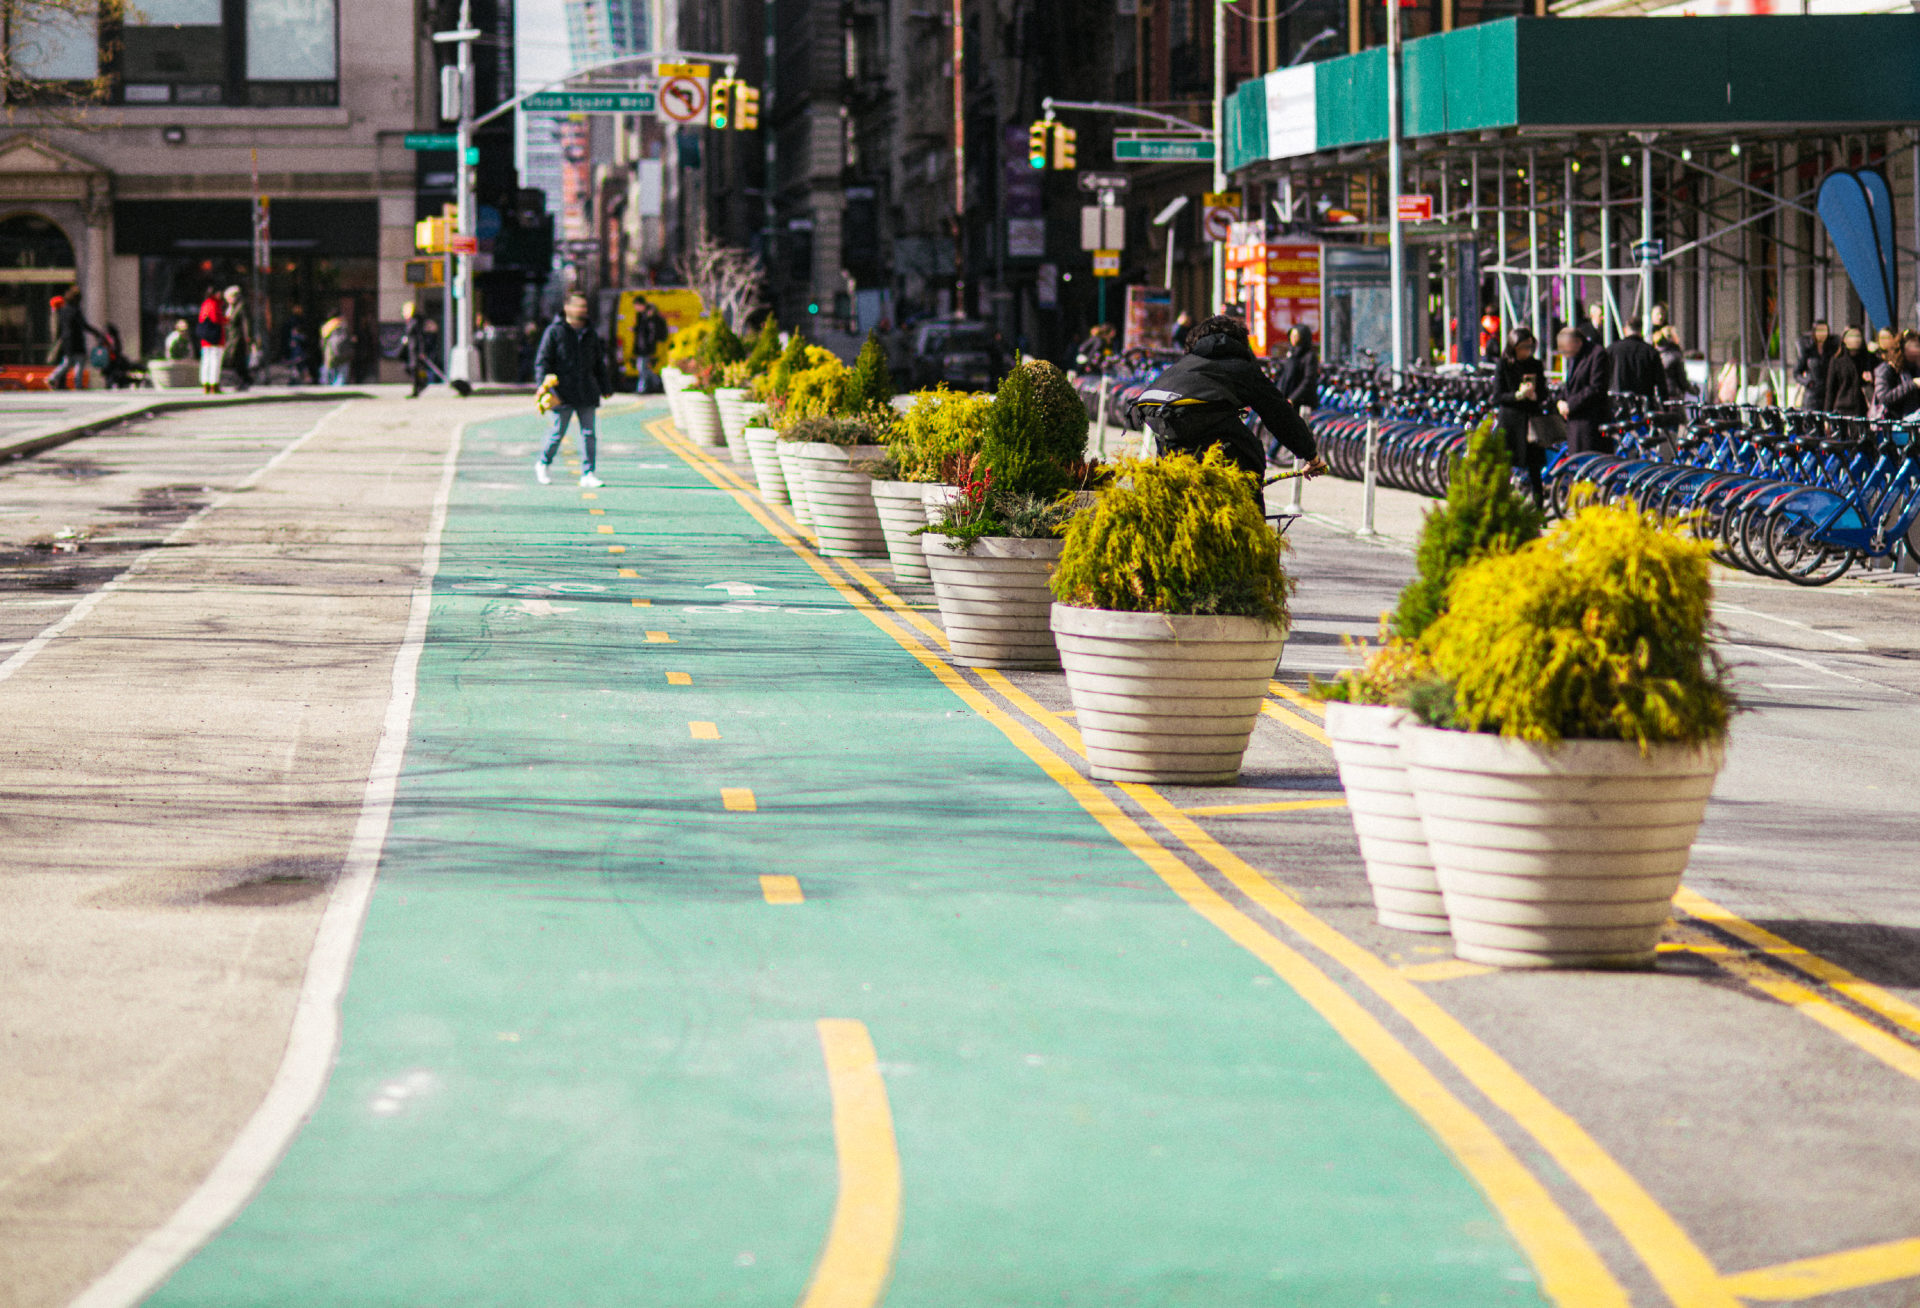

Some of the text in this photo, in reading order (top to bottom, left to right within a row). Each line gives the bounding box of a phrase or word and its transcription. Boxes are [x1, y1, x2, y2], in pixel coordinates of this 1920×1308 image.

[525, 96, 652, 110] Union Square West
[1141, 144, 1198, 158] Broadway
